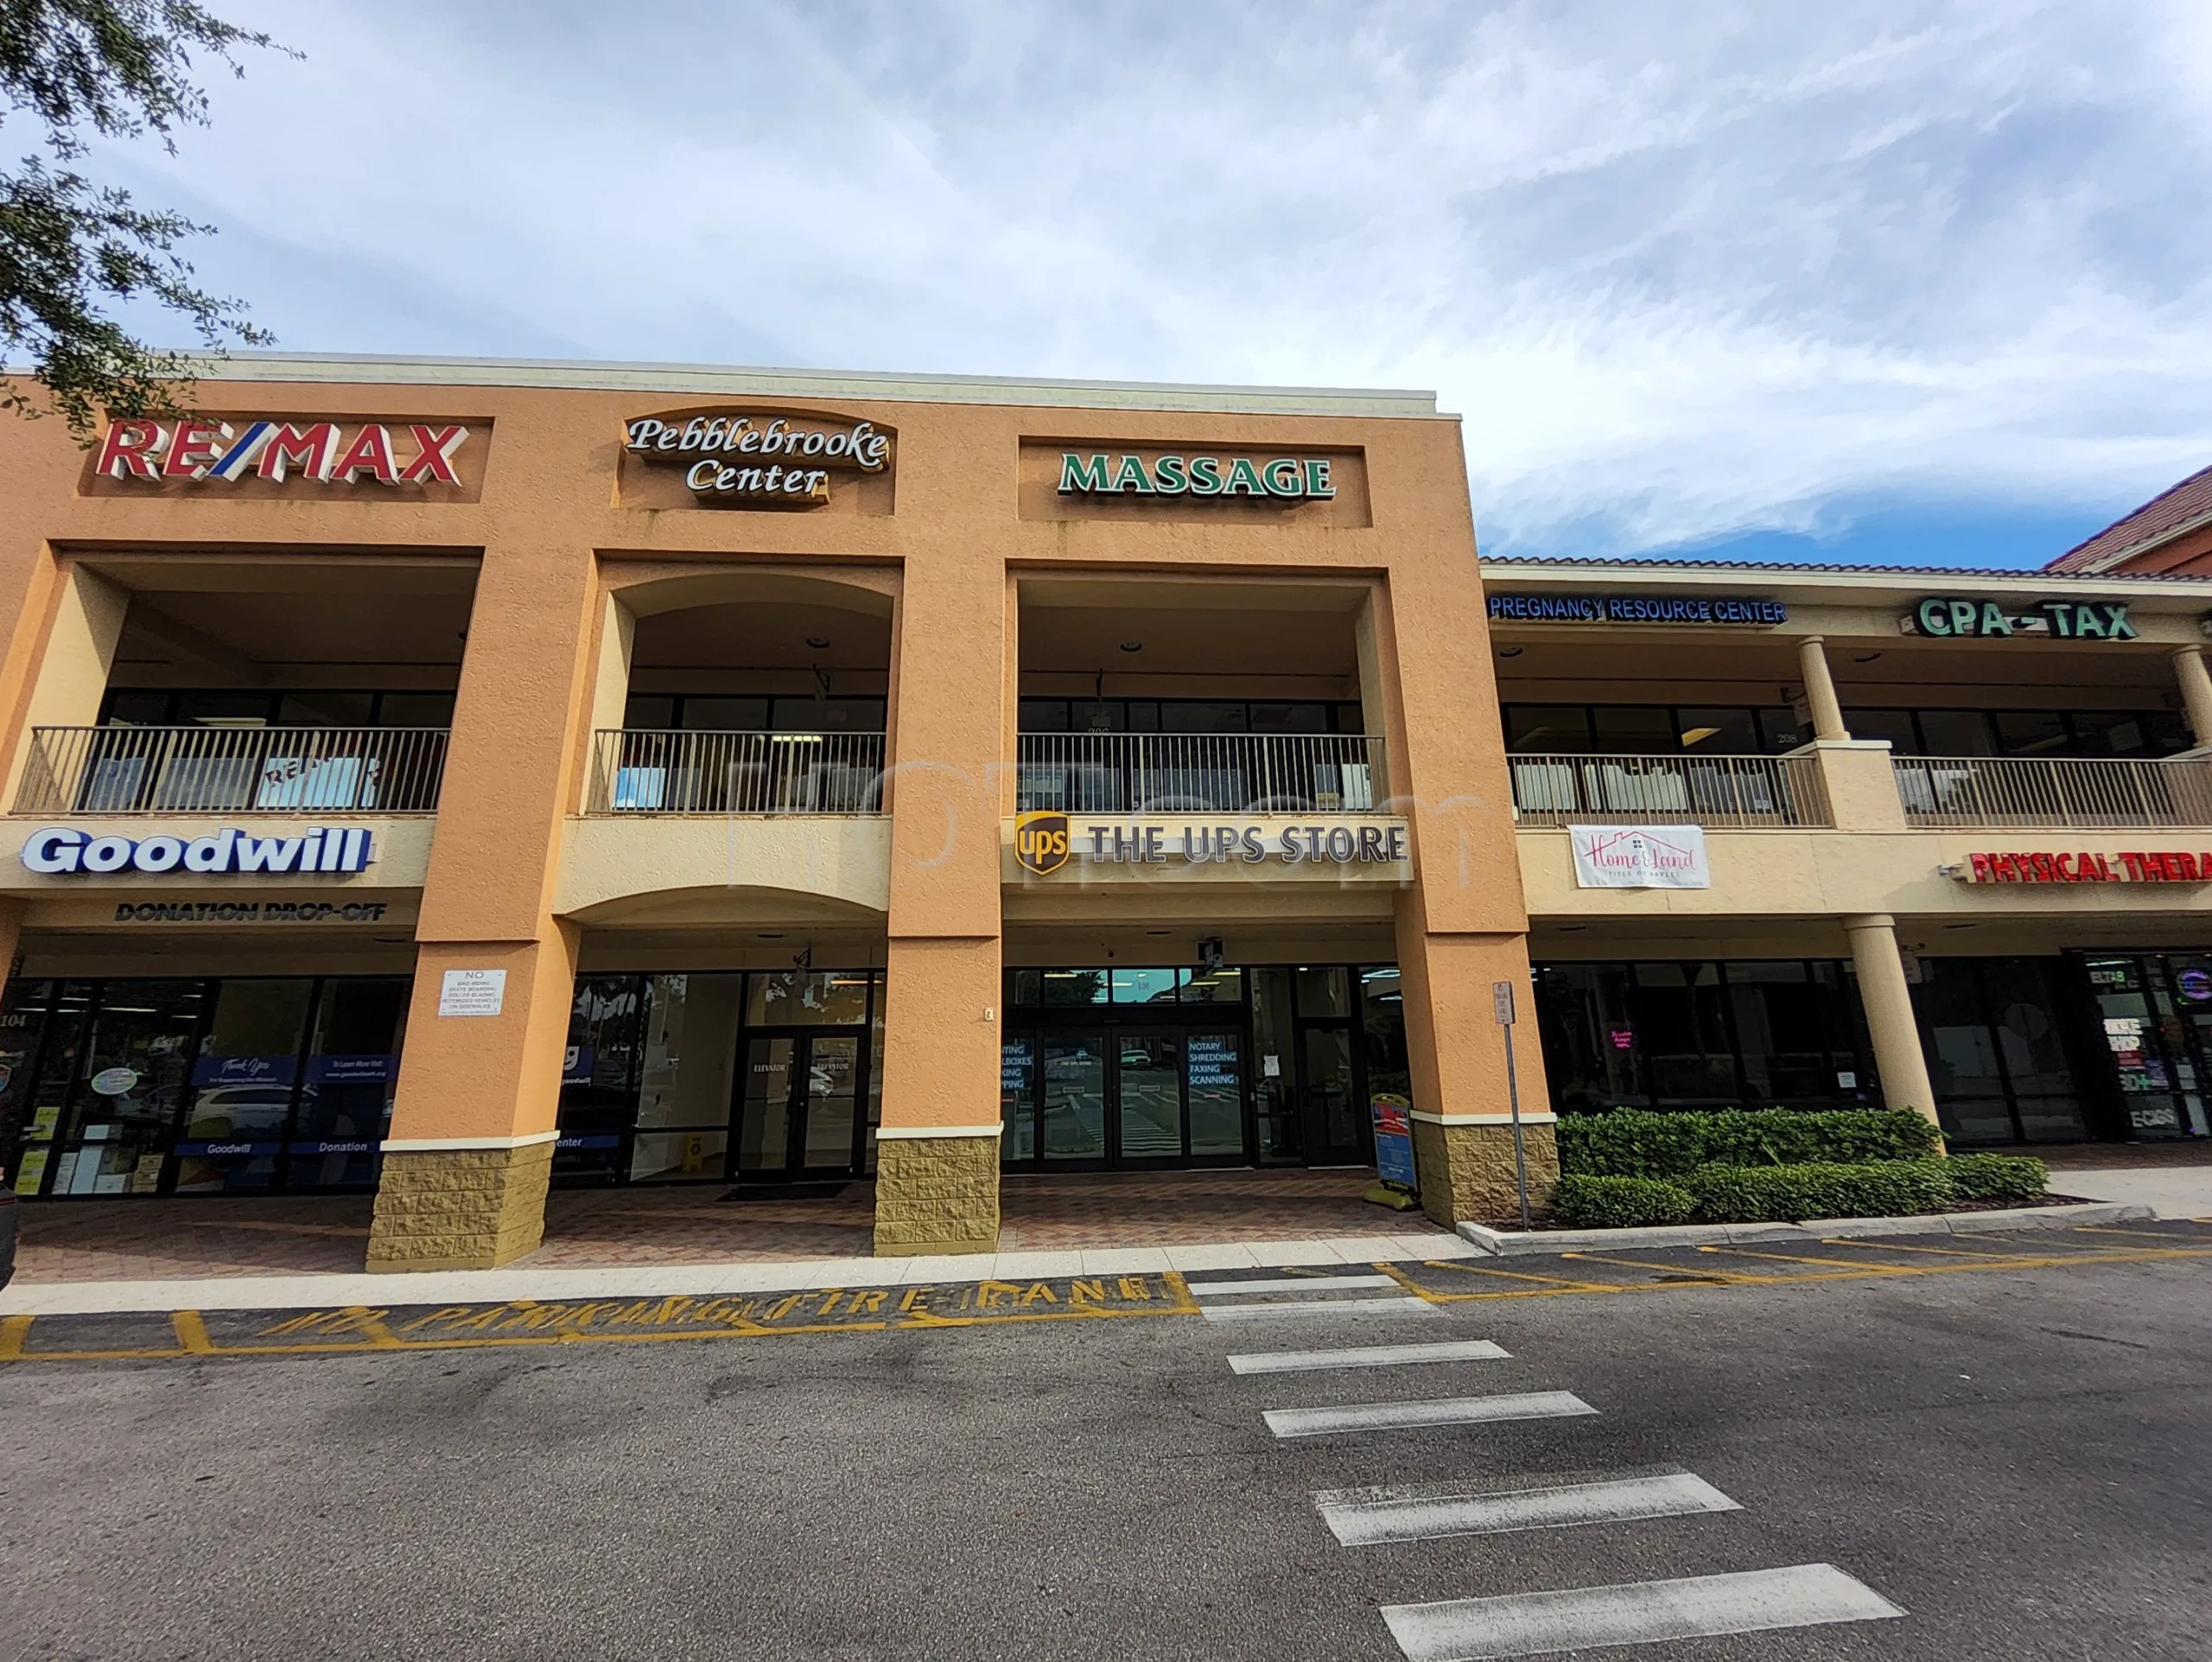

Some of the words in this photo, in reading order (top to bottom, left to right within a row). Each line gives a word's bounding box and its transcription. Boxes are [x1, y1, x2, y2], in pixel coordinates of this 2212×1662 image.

[96, 418, 468, 486] RE/MAX
[626, 417, 889, 470] Pebblebrooke
[685, 459, 829, 497] Center
[1058, 453, 1337, 498] MASSAGE
[1490, 597, 1606, 620] PREGNANCY
[1610, 599, 1711, 621] RESOURCE
[1714, 602, 1789, 622] CENTER
[22, 826, 372, 874] Goodwill
[1019, 831, 1067, 864] ups
[1087, 825, 1167, 863] THE
[1184, 826, 1266, 863] UPS
[1281, 826, 1408, 863] STORE
[1586, 834, 1642, 869] Home
[1651, 848, 1696, 870] Land
[1969, 852, 2120, 882] PHYSICAL
[114, 902, 258, 921] DONATION
[263, 902, 387, 921] DROP-OFF
[465, 971, 485, 979] NO
[1002, 1046, 1024, 1054] TING
[1189, 1042, 1220, 1051] NOTARY
[1002, 1057, 1032, 1066] LBOXES
[1189, 1053, 1236, 1061] SHREDDING
[1190, 1064, 1220, 1073] FAXING
[1189, 1075, 1234, 1084] SCANNING
[207, 1143, 251, 1153] Goodwill
[319, 1142, 367, 1152] Donation
[556, 1138, 583, 1148] enter
